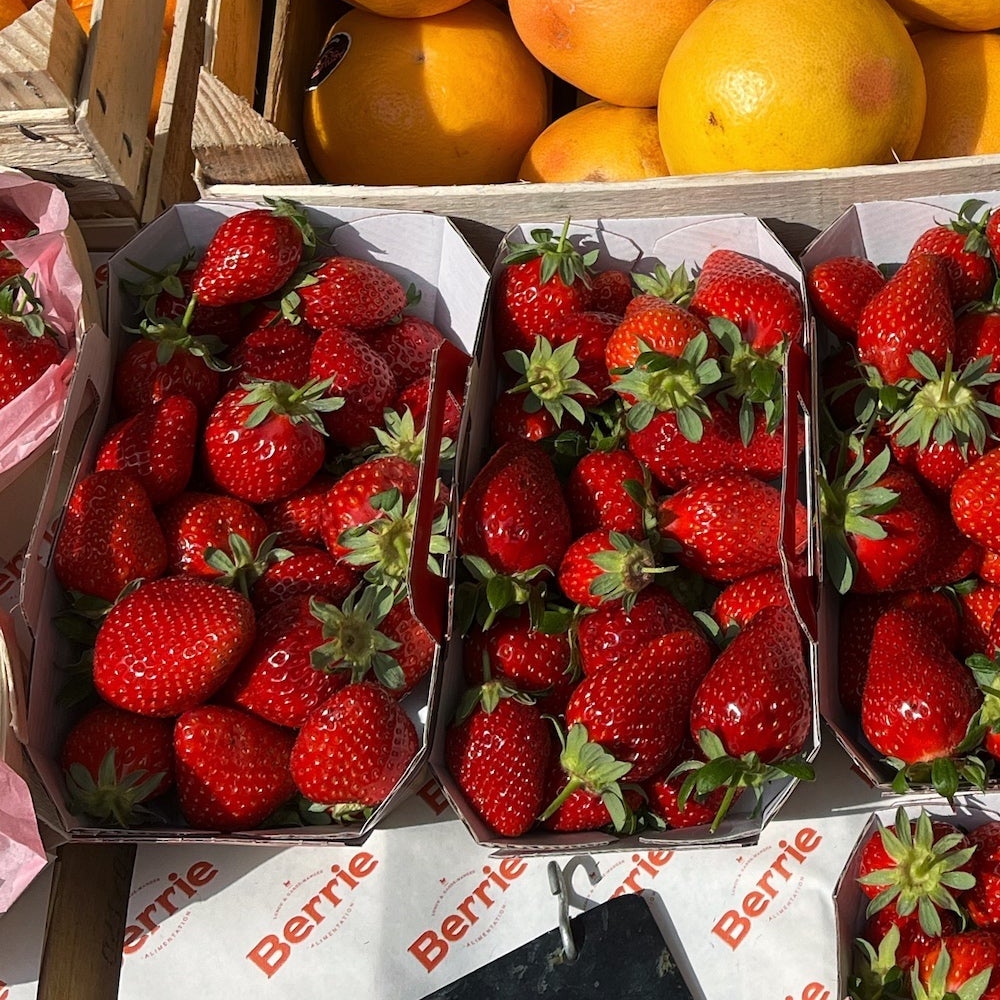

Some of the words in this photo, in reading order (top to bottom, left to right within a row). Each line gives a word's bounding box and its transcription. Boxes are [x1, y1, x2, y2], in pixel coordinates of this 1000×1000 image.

[711, 827, 822, 952] Berrie
[768, 876, 805, 921] ALIMENTATION
[144, 910, 192, 959] ALIMENTATION
[246, 852, 379, 979] Berrie
[310, 902, 355, 949] ALIMENTATION
[407, 856, 529, 974] Berrie
[466, 904, 507, 948] ALIMENTATION
